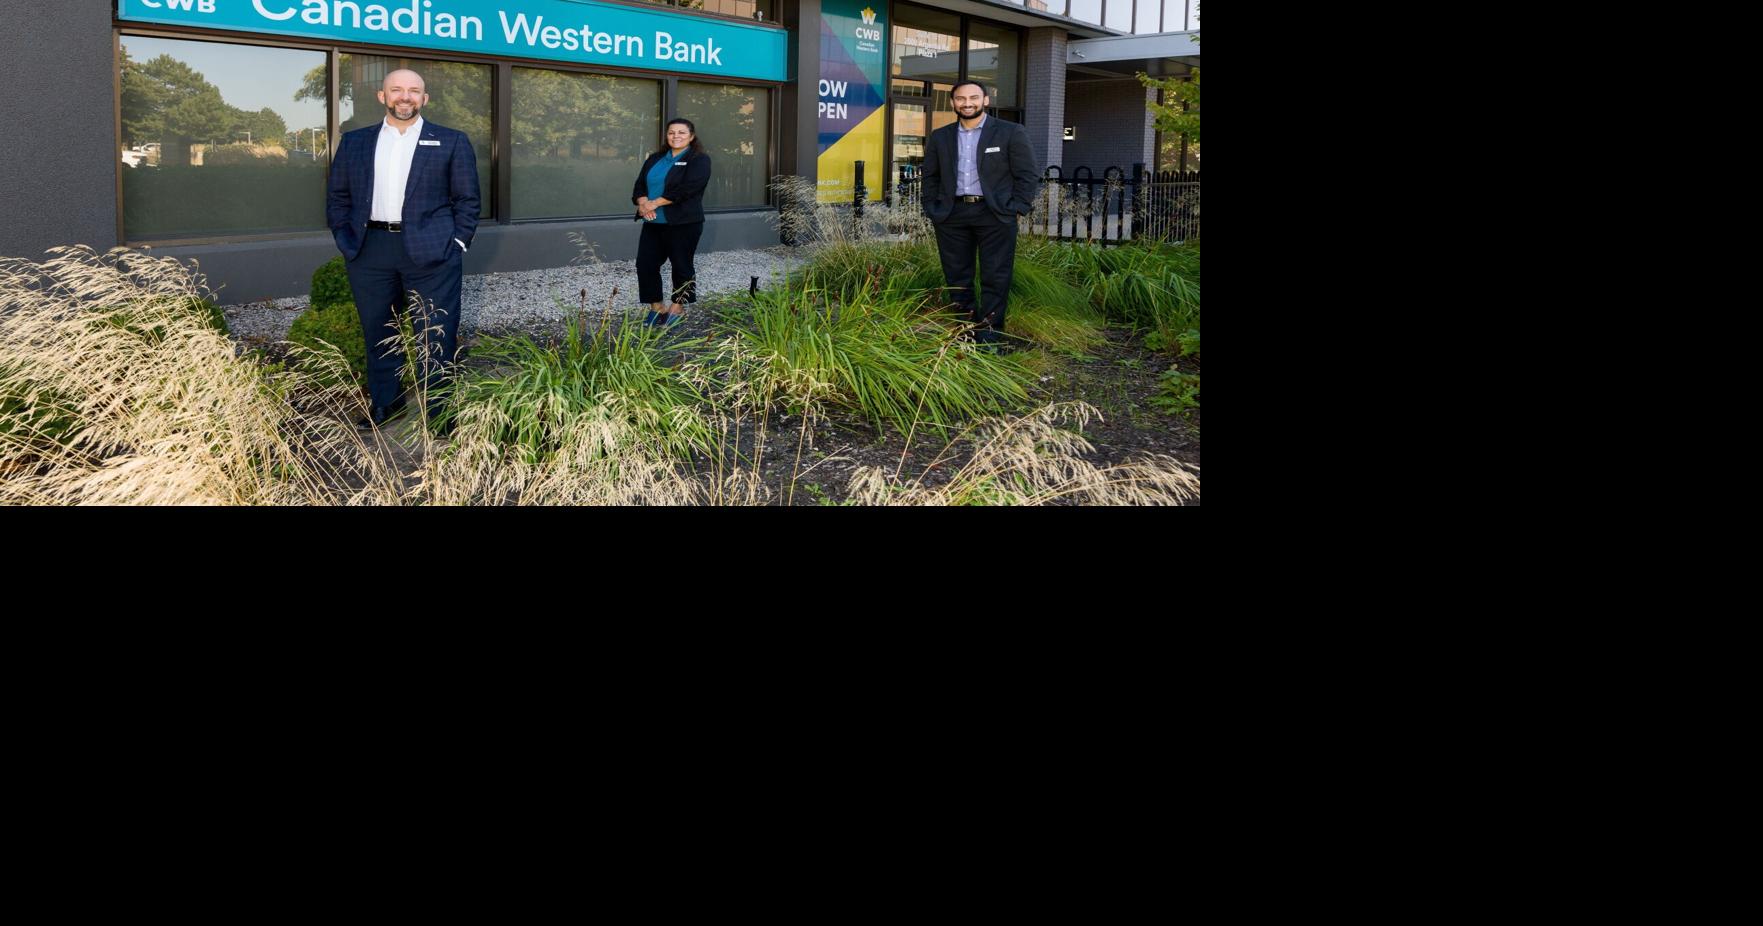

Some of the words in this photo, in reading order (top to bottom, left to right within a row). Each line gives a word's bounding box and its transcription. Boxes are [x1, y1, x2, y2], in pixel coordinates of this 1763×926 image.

[252, 0, 483, 41] Canadian
[498, 10, 644, 58] Western
[655, 31, 723, 66] Bank
[855, 27, 880, 41] CWB
